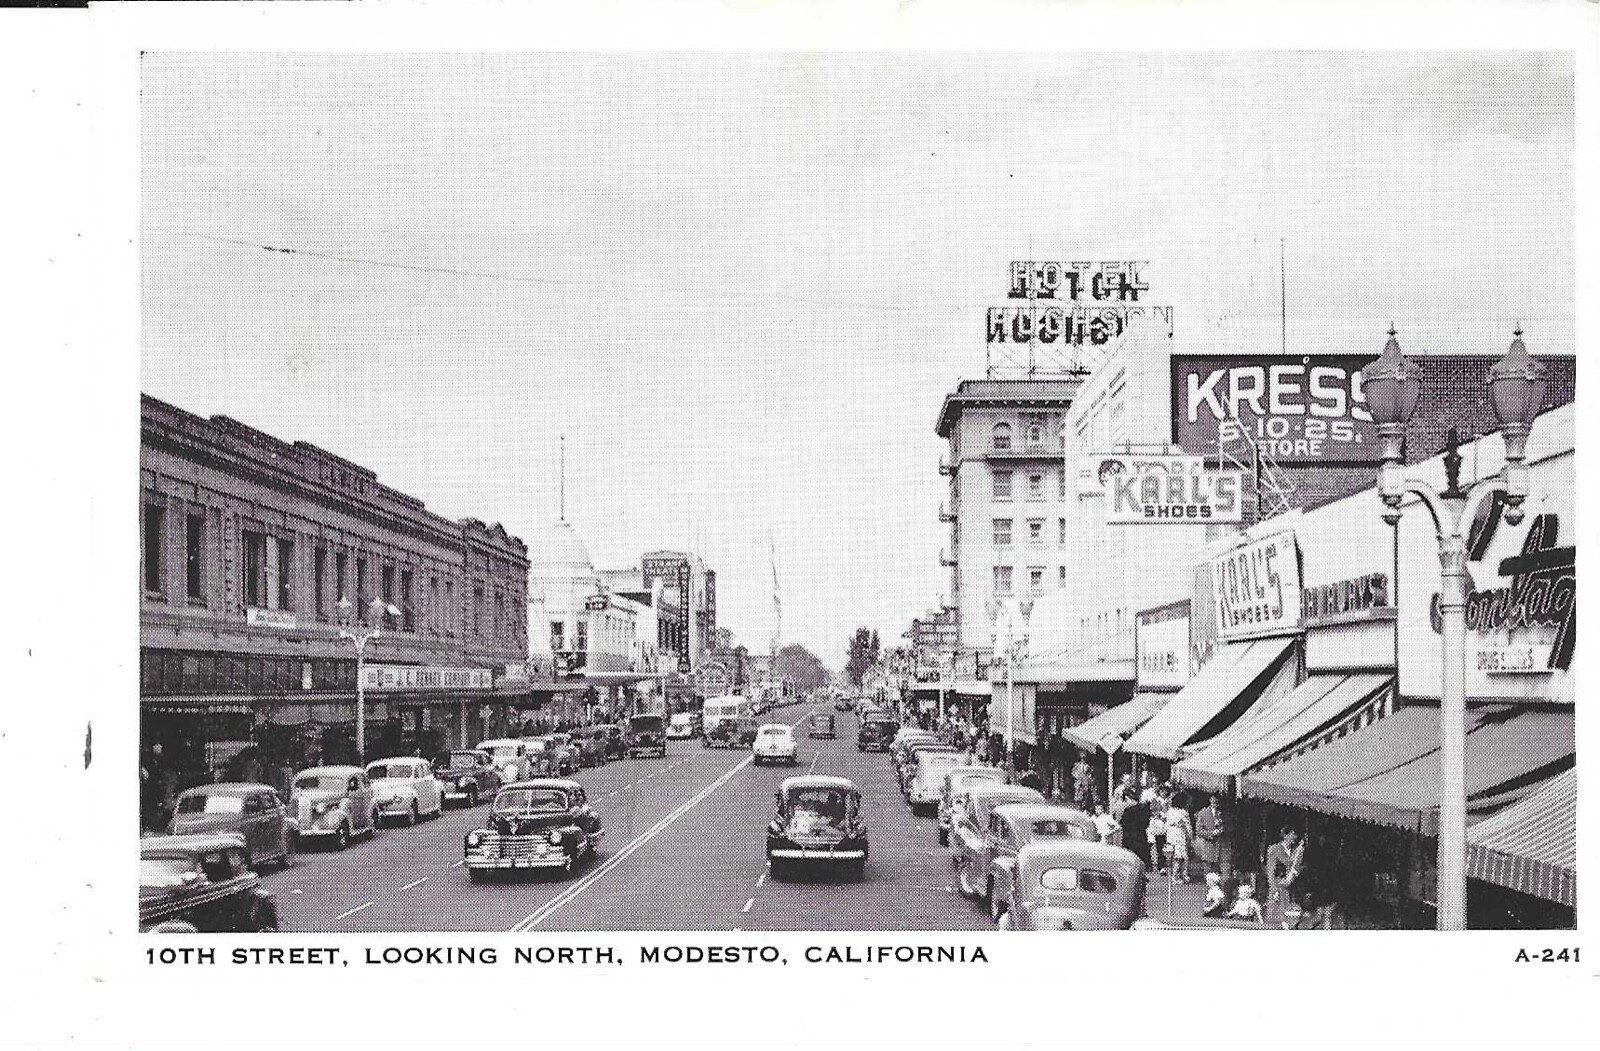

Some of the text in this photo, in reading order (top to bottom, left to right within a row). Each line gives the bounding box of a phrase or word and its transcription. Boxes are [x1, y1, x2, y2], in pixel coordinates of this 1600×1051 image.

[1009, 261, 1150, 297] HOTEL
[1258, 439, 1323, 457] STORE
[1113, 475, 1236, 513] KARL'S
[1144, 505, 1213, 518] SHOES
[1216, 543, 1284, 629] KARL'S
[1232, 603, 1271, 627] SHOES
